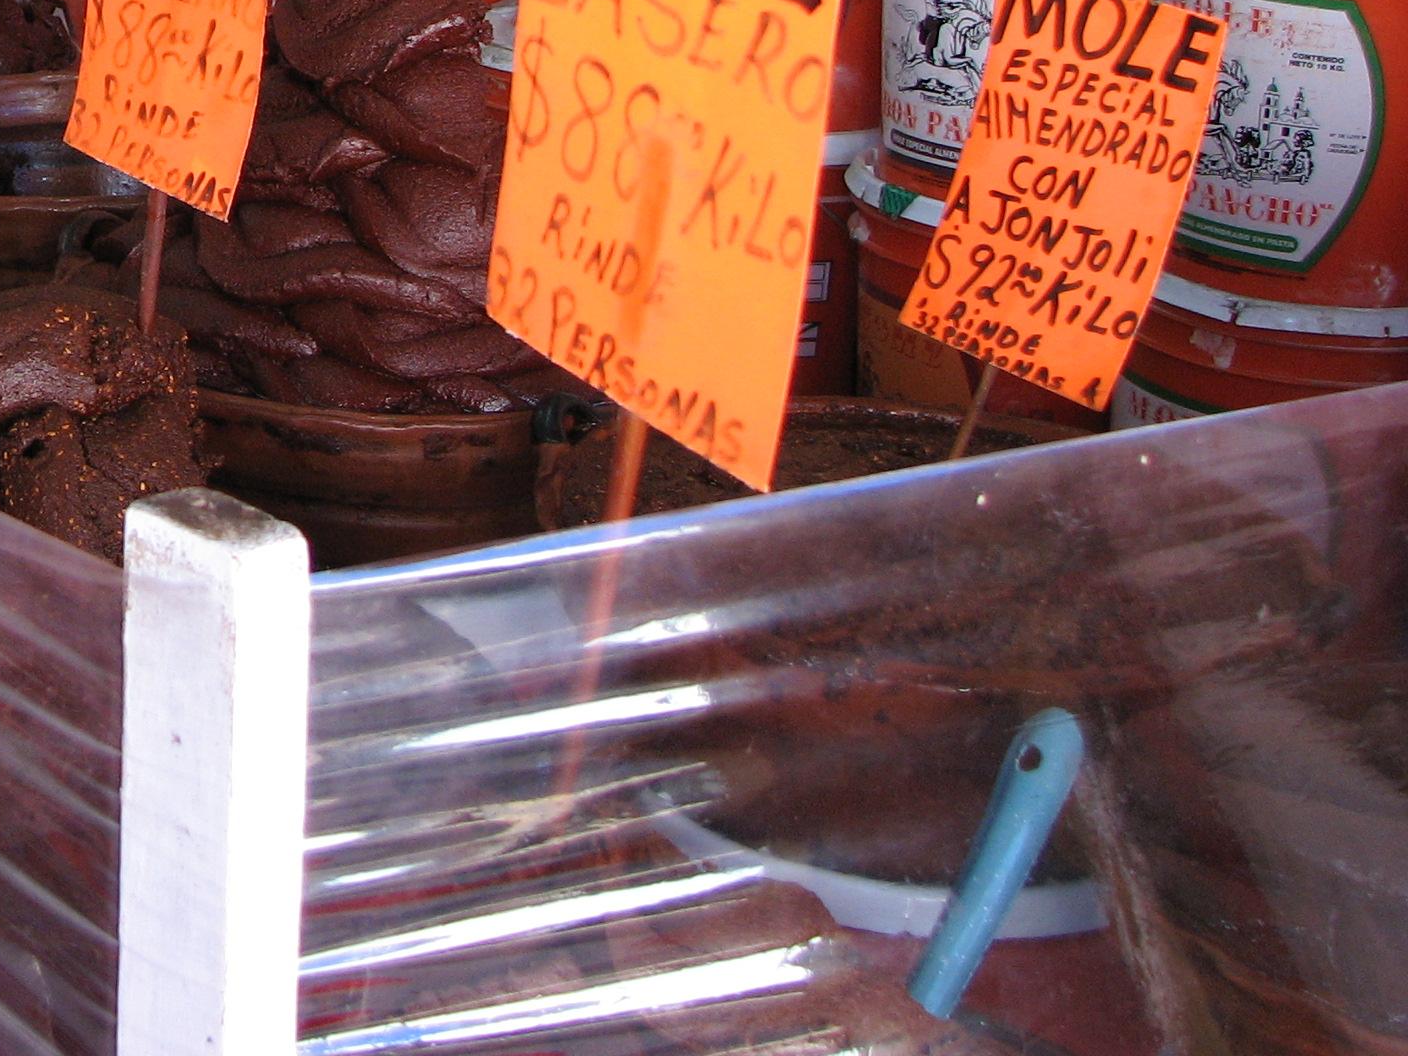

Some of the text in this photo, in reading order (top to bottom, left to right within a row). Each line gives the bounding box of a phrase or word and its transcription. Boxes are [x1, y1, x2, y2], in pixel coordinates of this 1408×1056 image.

[927, 110, 969, 143] PA
[105, 124, 232, 219] PERSONAS
[1006, 155, 1097, 209] CON
[488, 245, 745, 464] 32 PERSONAS
[910, 309, 1066, 391] 32 PERSONAS
